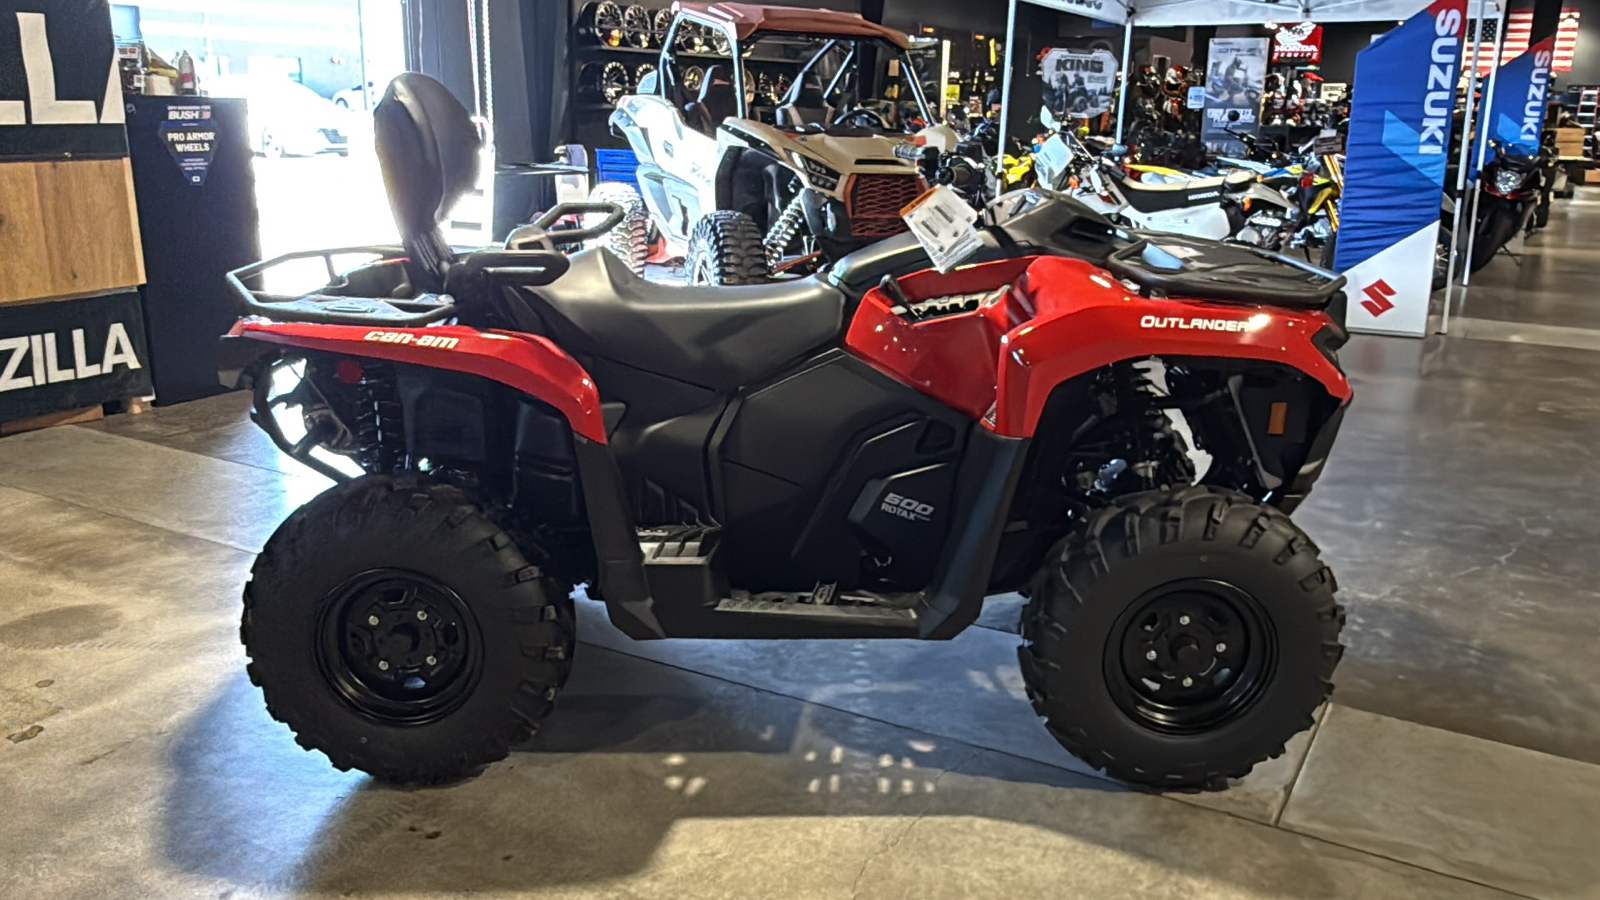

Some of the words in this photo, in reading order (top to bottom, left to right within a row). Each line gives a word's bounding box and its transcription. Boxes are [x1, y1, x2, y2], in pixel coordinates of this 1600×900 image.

[1055, 59, 1104, 73] KING
[1419, 8, 1462, 154] SUZUKI
[1520, 51, 1550, 140] SUZUKI
[168, 110, 199, 119] BUSH
[167, 132, 185, 141] PRO
[186, 132, 215, 141] ARMOR
[175, 143, 210, 152] WHEELS
[1187, 191, 1221, 201] HONDA
[1140, 315, 1257, 332] OUTLANDER
[363, 330, 459, 349] can-am
[0, 323, 142, 392] ZILLA
[881, 502, 916, 521] ROTAX
[884, 492, 935, 515] 500
